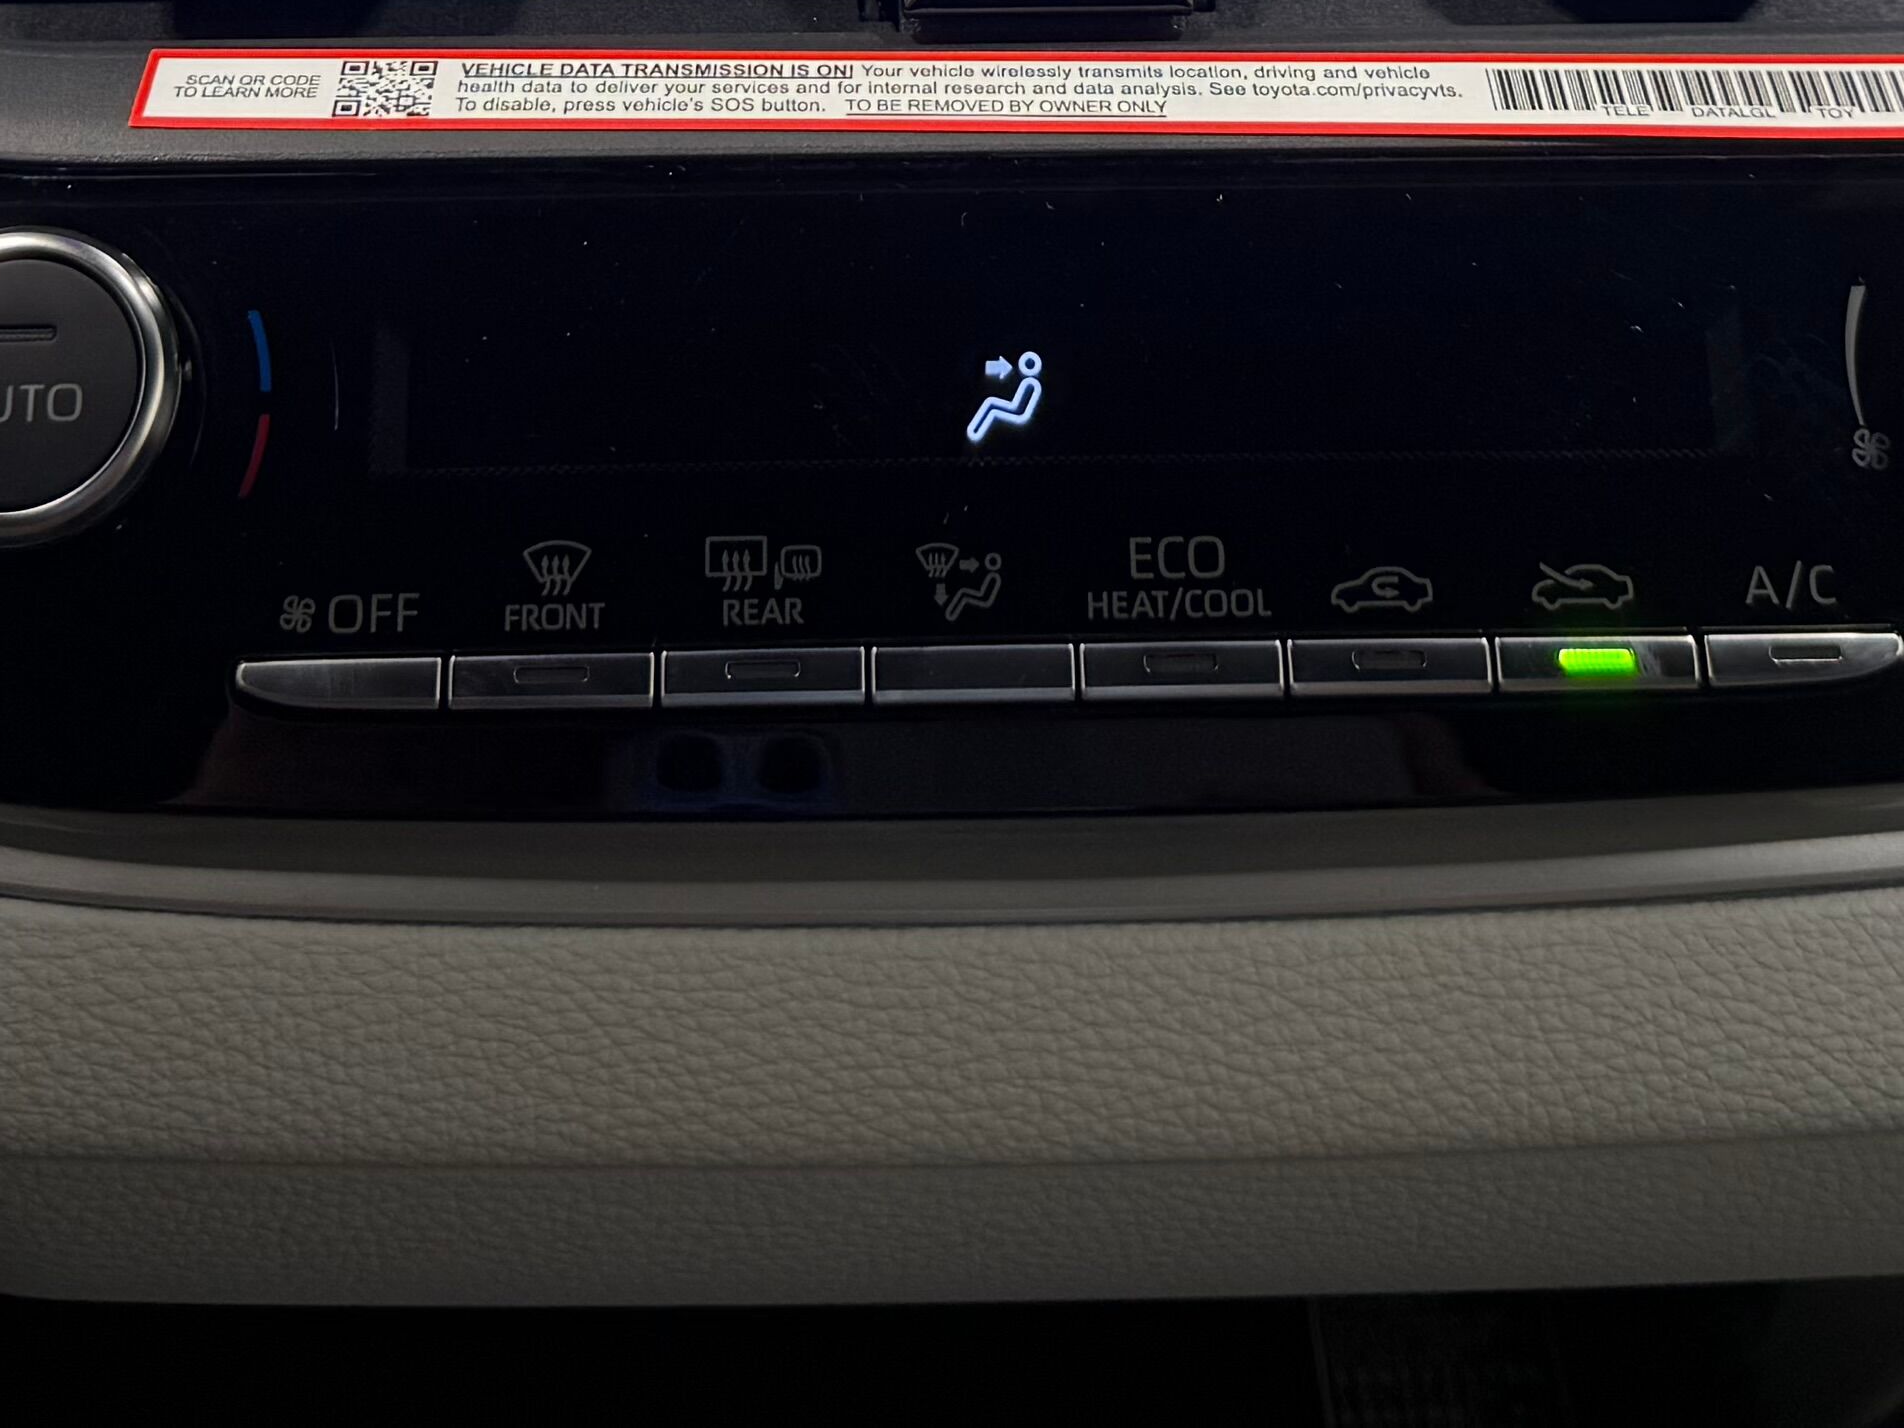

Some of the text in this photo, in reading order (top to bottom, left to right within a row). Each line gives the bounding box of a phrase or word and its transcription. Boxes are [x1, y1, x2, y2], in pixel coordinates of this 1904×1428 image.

[186, 74, 321, 86] SCAN QR CODE
[461, 63, 1430, 82] VEHICLE DATA TRANSMISSION IS ON! Your vehicle wirelessly transmits location, driving and vehicle
[175, 86, 318, 98] TO LEARN MORE
[457, 80, 515, 94] health
[521, 80, 562, 94] data
[571, 81, 588, 94] to
[596, 80, 658, 94] deliver
[664, 83, 705, 97] your
[712, 81, 789, 95] services
[796, 81, 831, 94] and
[837, 80, 860, 94] for
[868, 81, 937, 95] internal
[944, 81, 1026, 95] research
[1032, 82, 1067, 95] and
[1073, 82, 1114, 95] data
[1120, 82, 1203, 98] analysis.
[1209, 82, 1246, 96] See
[456, 97, 1167, 115] To disable, press vehicle's SOS button. TO BE REMOVED BY OWNER ONLY
[1600, 105, 1859, 120] TELE DATALGL TOY
[1130, 535, 1225, 580] ECO
[1745, 561, 1837, 609] A/C
[328, 591, 421, 634] OFF
[722, 597, 805, 626] REAR
[1087, 587, 1273, 621] HEAT/COOL
[504, 602, 606, 632] FRONT
